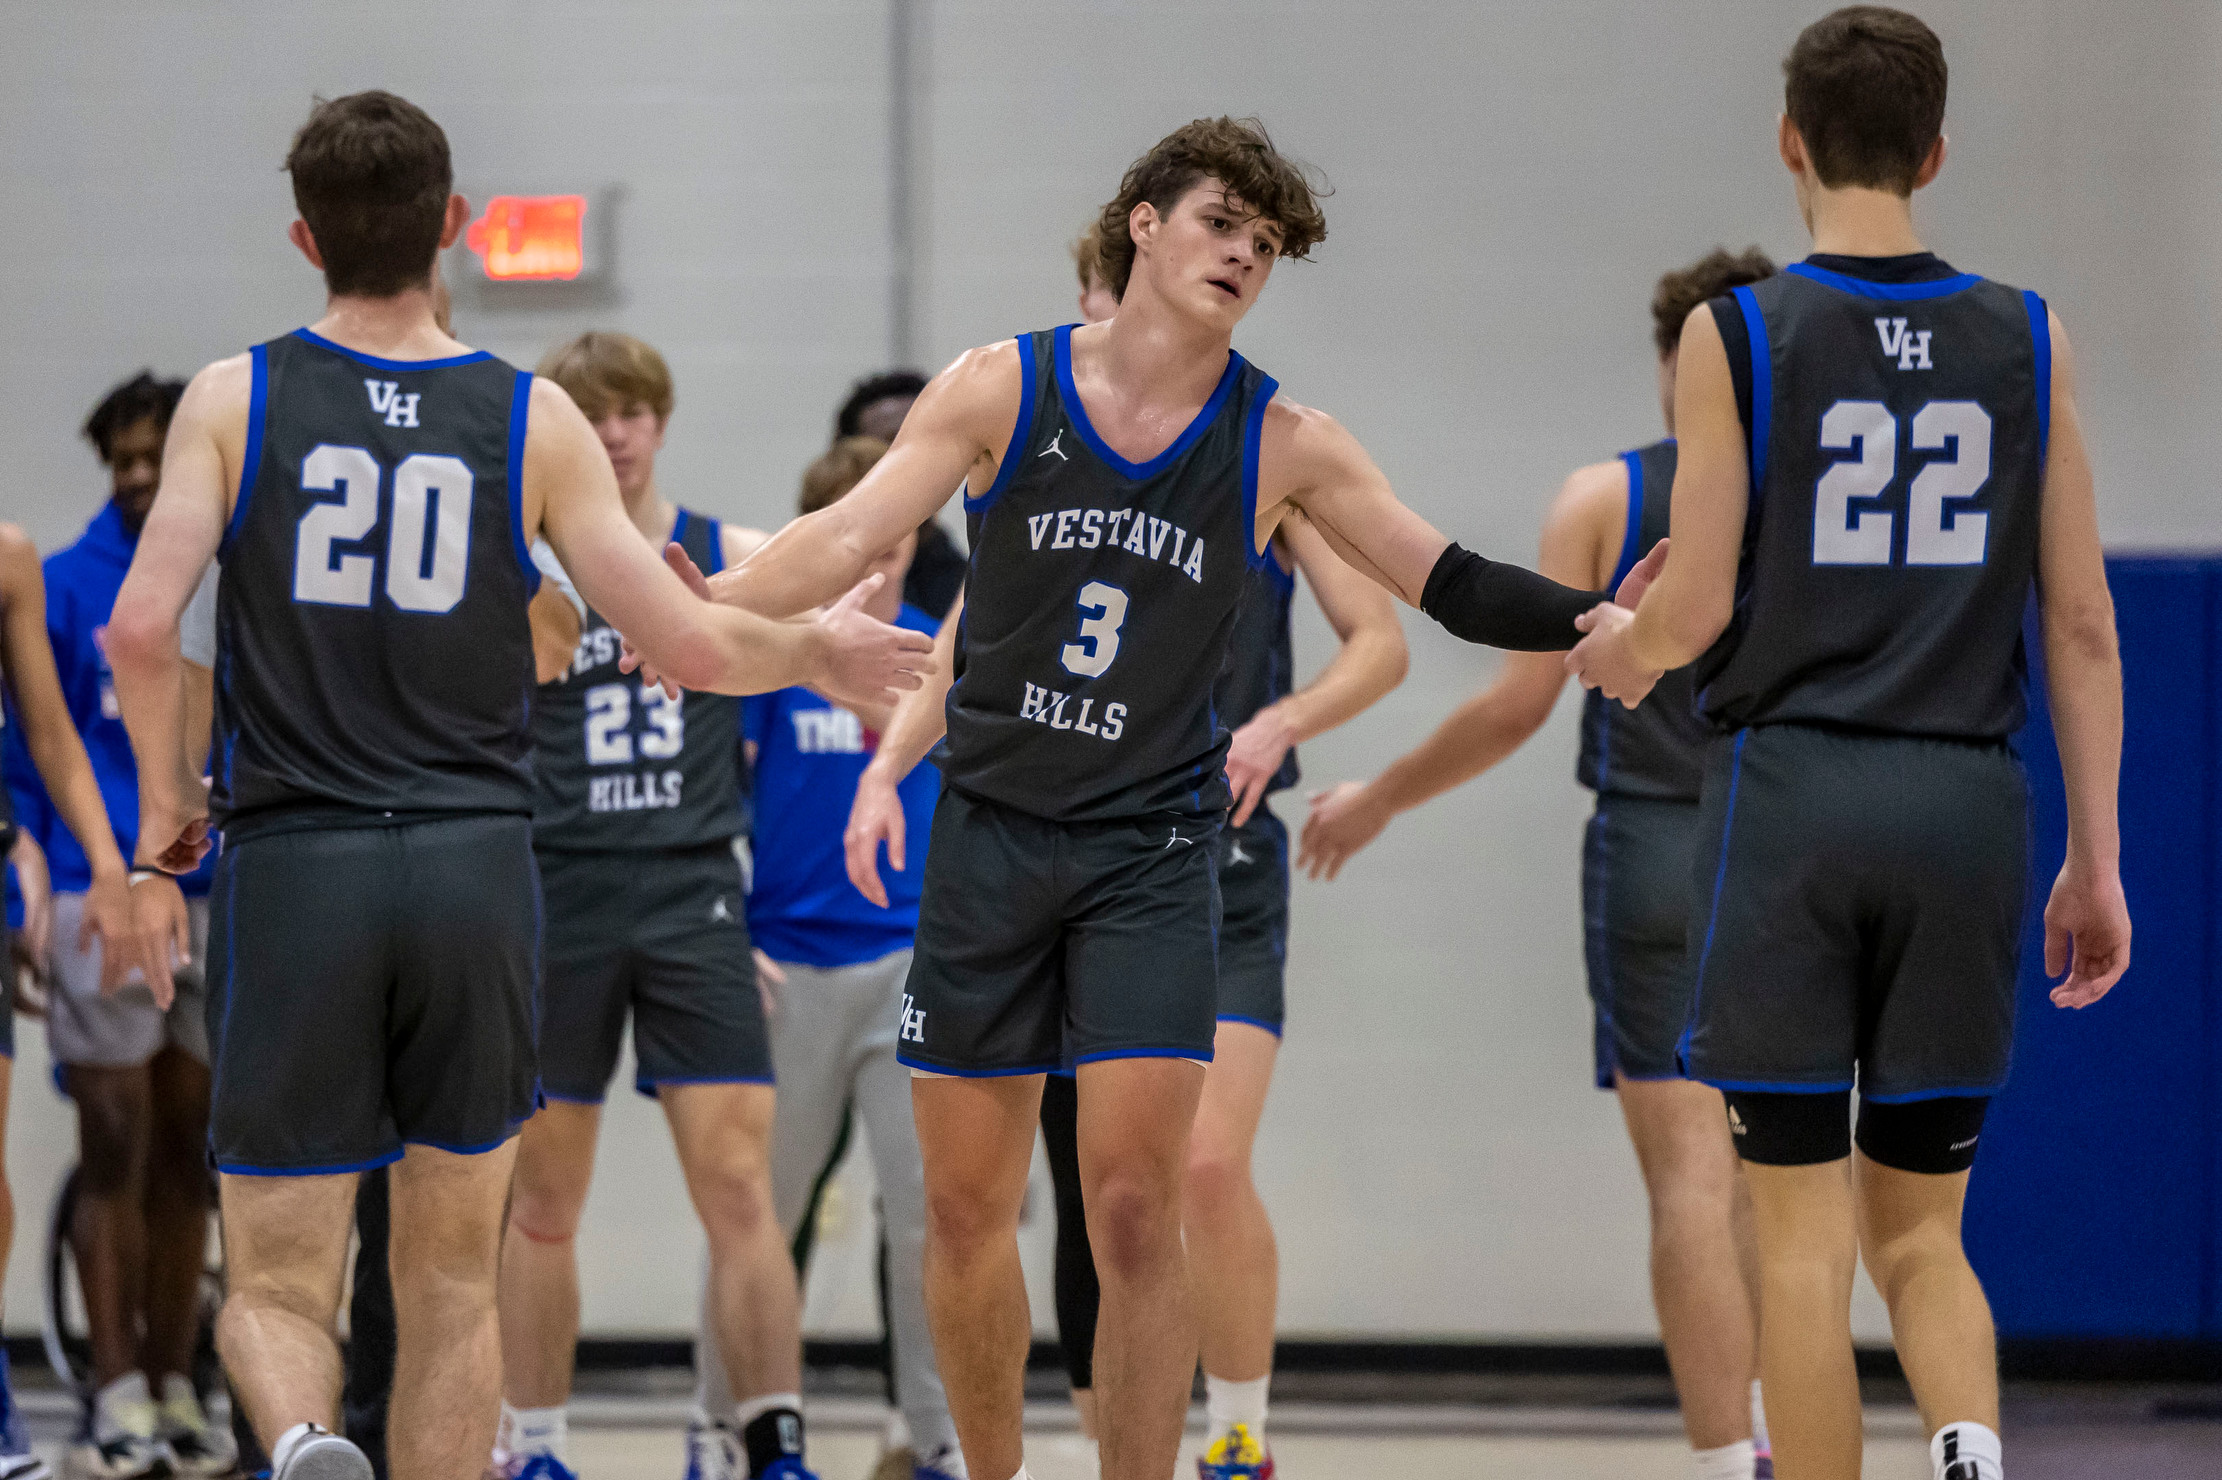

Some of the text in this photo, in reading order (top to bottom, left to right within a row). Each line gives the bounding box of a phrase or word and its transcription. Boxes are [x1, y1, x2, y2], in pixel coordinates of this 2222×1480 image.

[1875, 317, 1933, 370] VH
[364, 378, 421, 428] VH
[1812, 400, 1992, 566] 22
[293, 442, 475, 614] 20
[1028, 507, 1204, 583] VESTAVIA
[1060, 580, 1129, 679] 3
[584, 682, 684, 766] 23
[1020, 681, 1128, 741] HILLS
[588, 770, 684, 813] HILLS
